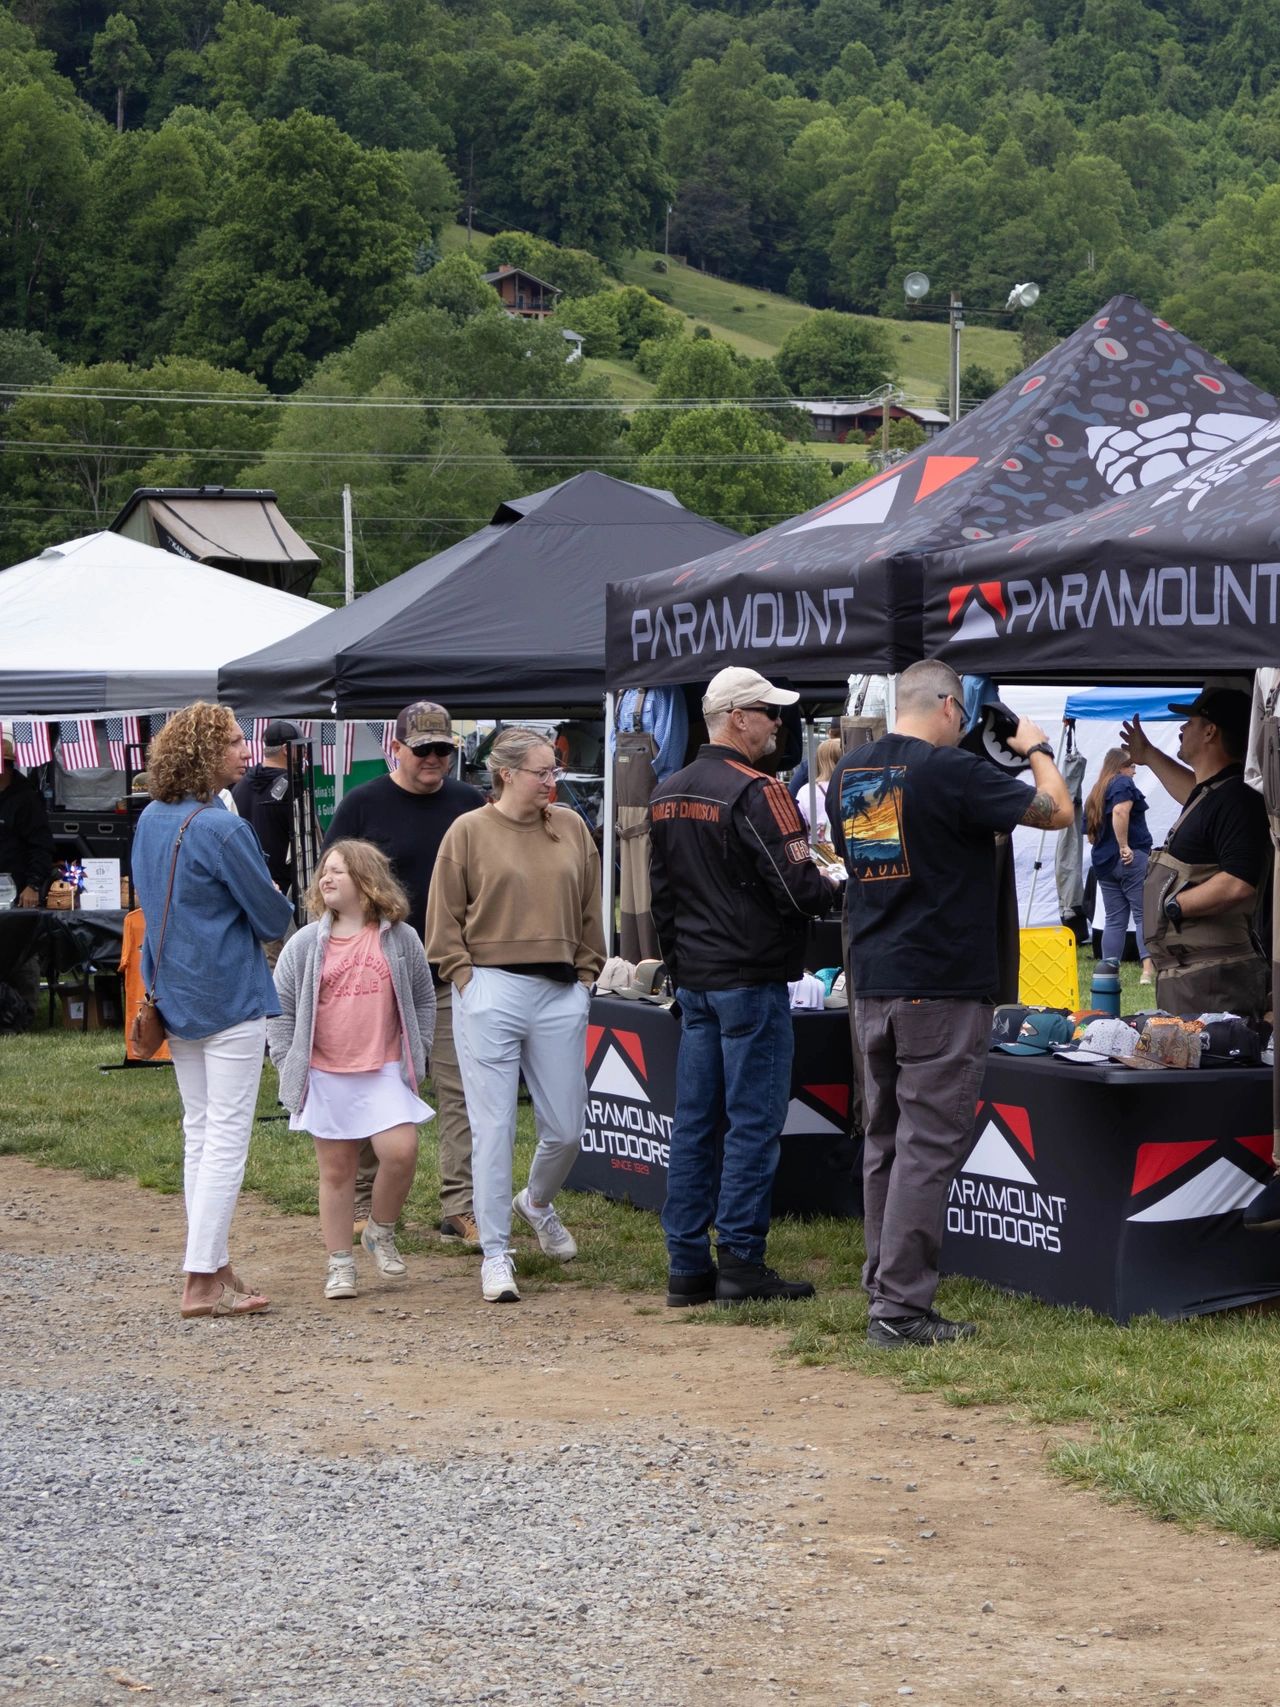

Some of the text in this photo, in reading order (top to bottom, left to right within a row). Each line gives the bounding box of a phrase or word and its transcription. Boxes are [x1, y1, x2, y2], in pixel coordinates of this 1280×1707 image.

[632, 587, 855, 661] PARAMOUNT
[585, 1099, 674, 1141] RAMOUNT
[580, 1128, 671, 1169] OUTDOORS
[610, 1158, 633, 1171] SINCE
[948, 1178, 1067, 1224] ARAMOUNT
[947, 1207, 1062, 1253] OUTDOORS
